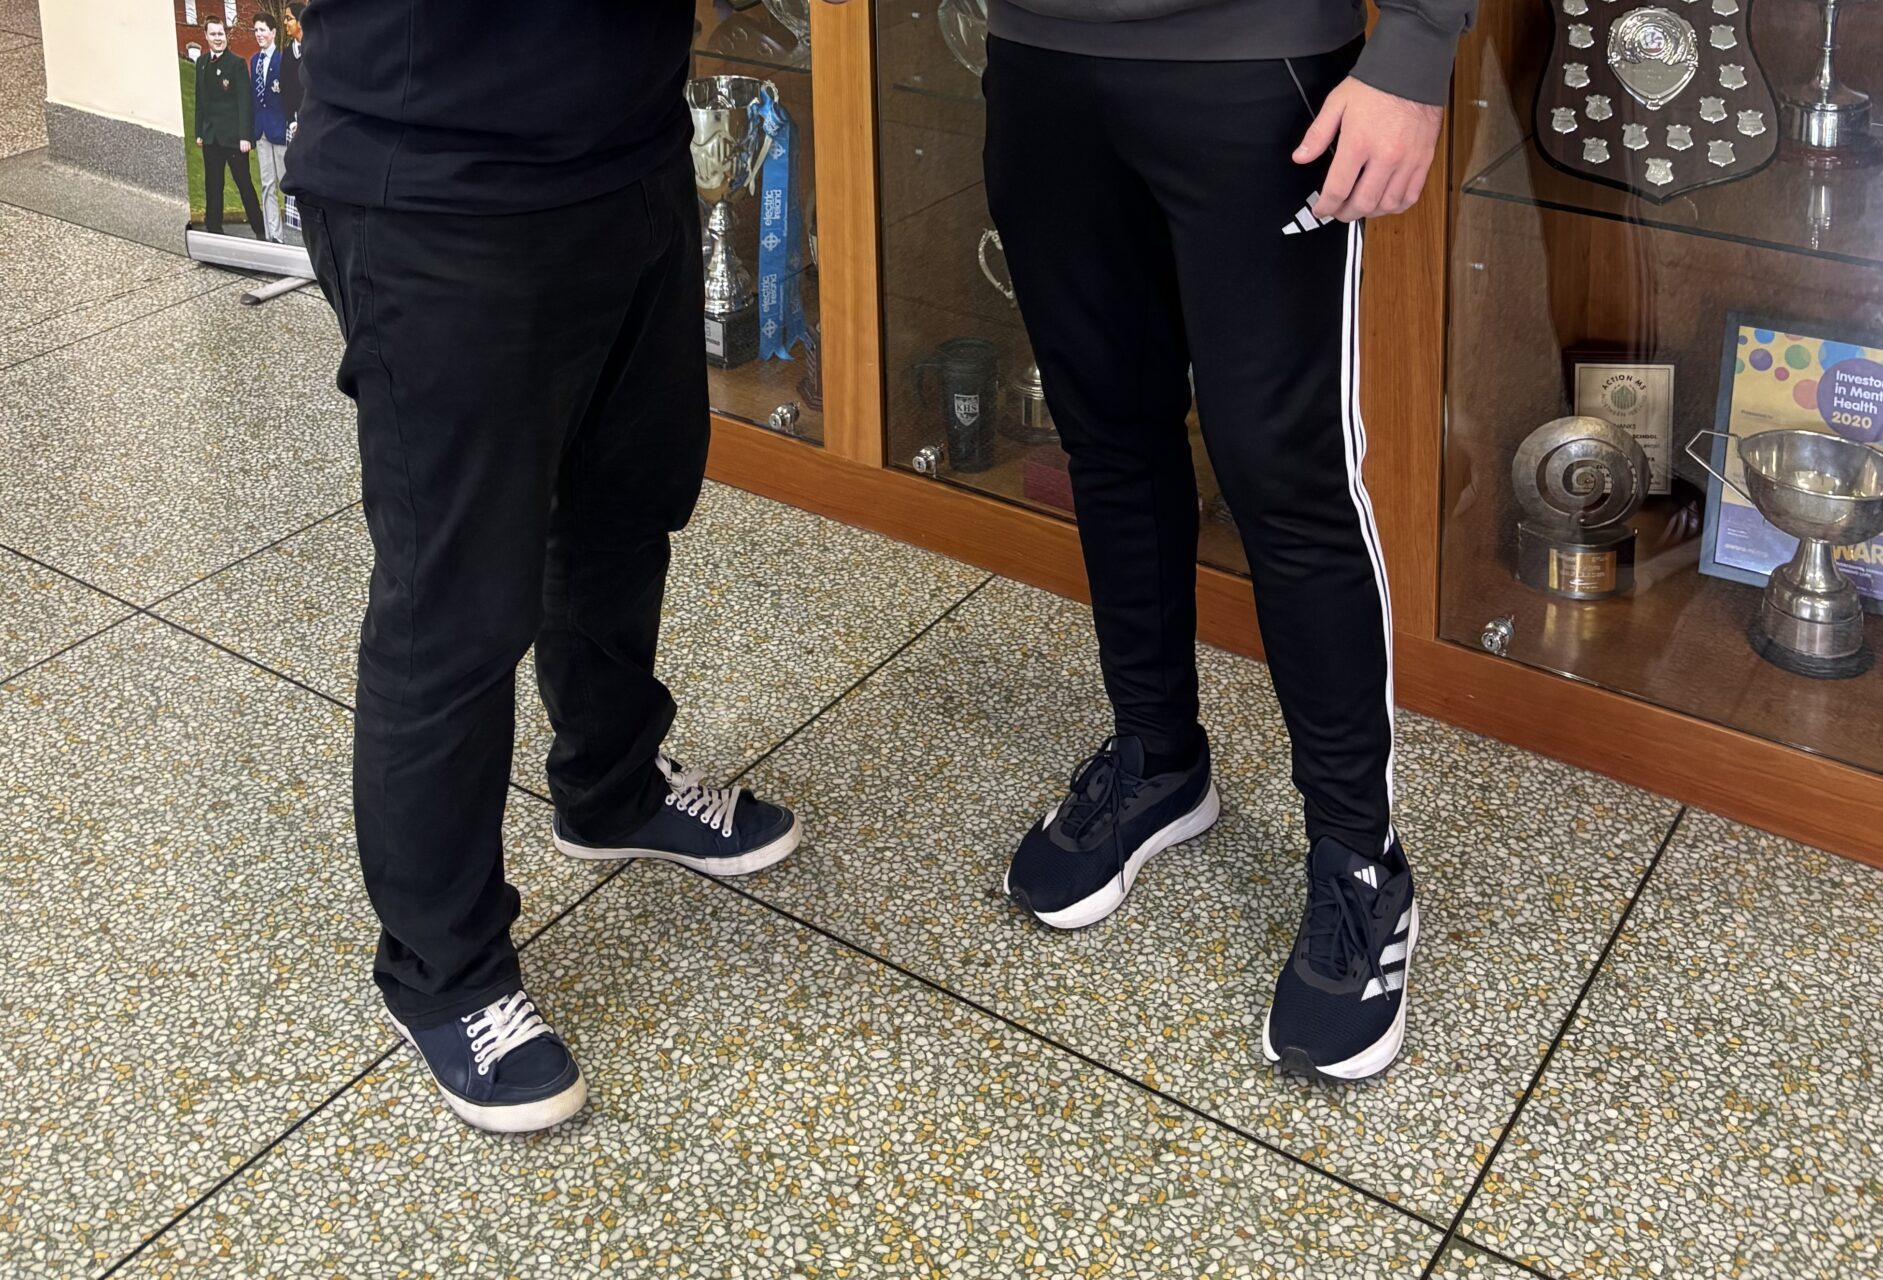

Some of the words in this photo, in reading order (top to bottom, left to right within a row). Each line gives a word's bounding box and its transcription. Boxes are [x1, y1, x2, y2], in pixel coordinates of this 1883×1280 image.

[763, 190, 773, 226] electric
[762, 275, 770, 313] electric
[1602, 374, 1633, 391] ACTION
[1635, 380, 1647, 391] MS
[1835, 383, 1846, 395] in
[956, 404, 977, 412] KHS
[1834, 396, 1878, 415] Health
[1832, 411, 1873, 430] 2020
